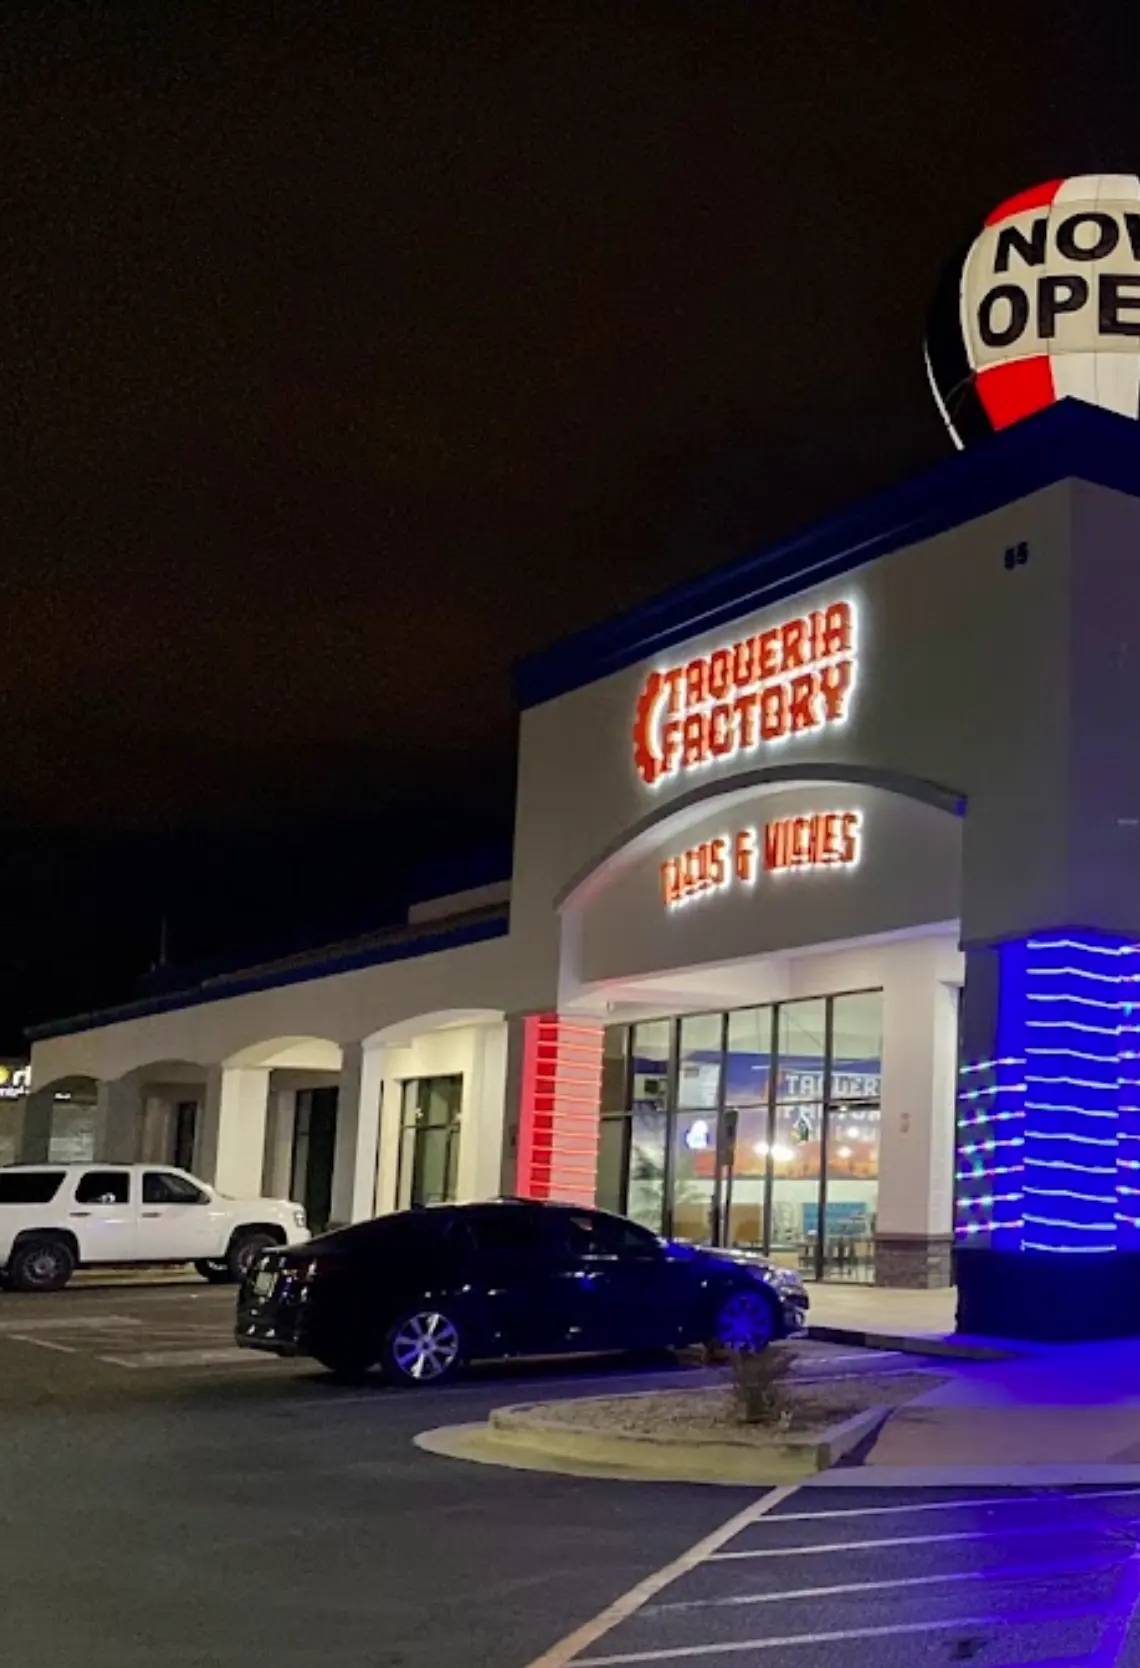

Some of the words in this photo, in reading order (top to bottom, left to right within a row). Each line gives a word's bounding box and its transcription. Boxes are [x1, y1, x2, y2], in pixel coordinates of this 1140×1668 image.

[662, 601, 852, 714] TAQUERIA
[659, 660, 854, 774] FACTORY
[660, 839, 726, 905] TACOS
[736, 831, 754, 880] &
